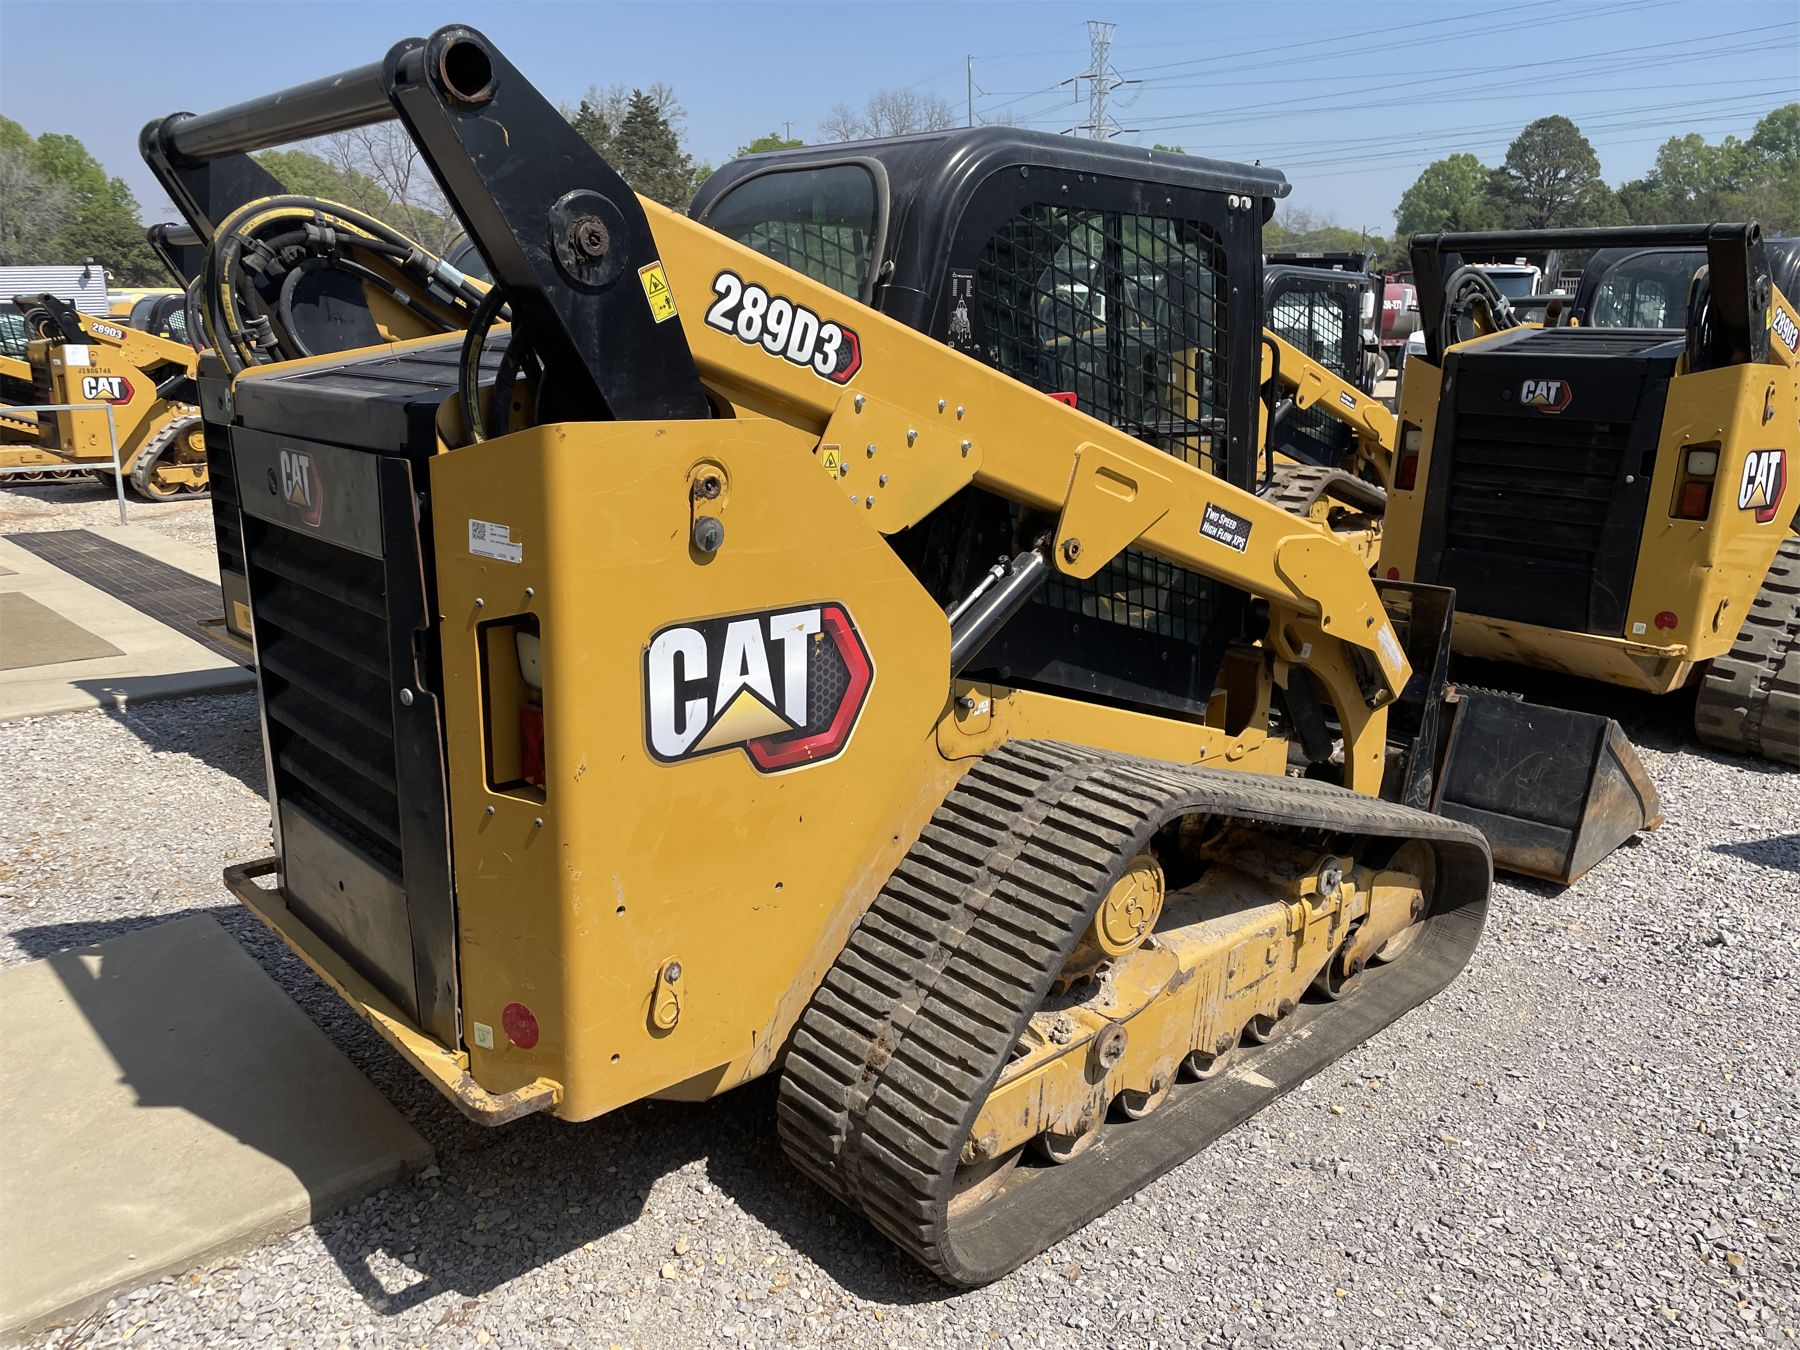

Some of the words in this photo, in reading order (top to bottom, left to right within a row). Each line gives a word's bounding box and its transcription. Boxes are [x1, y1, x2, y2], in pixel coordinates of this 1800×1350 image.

[92, 323, 122, 339] 289D3
[706, 273, 843, 375] 289D3
[1772, 306, 1799, 350] 289D3
[83, 377, 121, 399] CAT
[1521, 379, 1561, 406] CAT
[280, 449, 312, 507] CAT
[1739, 450, 1782, 509] CAT
[1232, 535, 1246, 549] XPS
[648, 607, 822, 758] CAT
